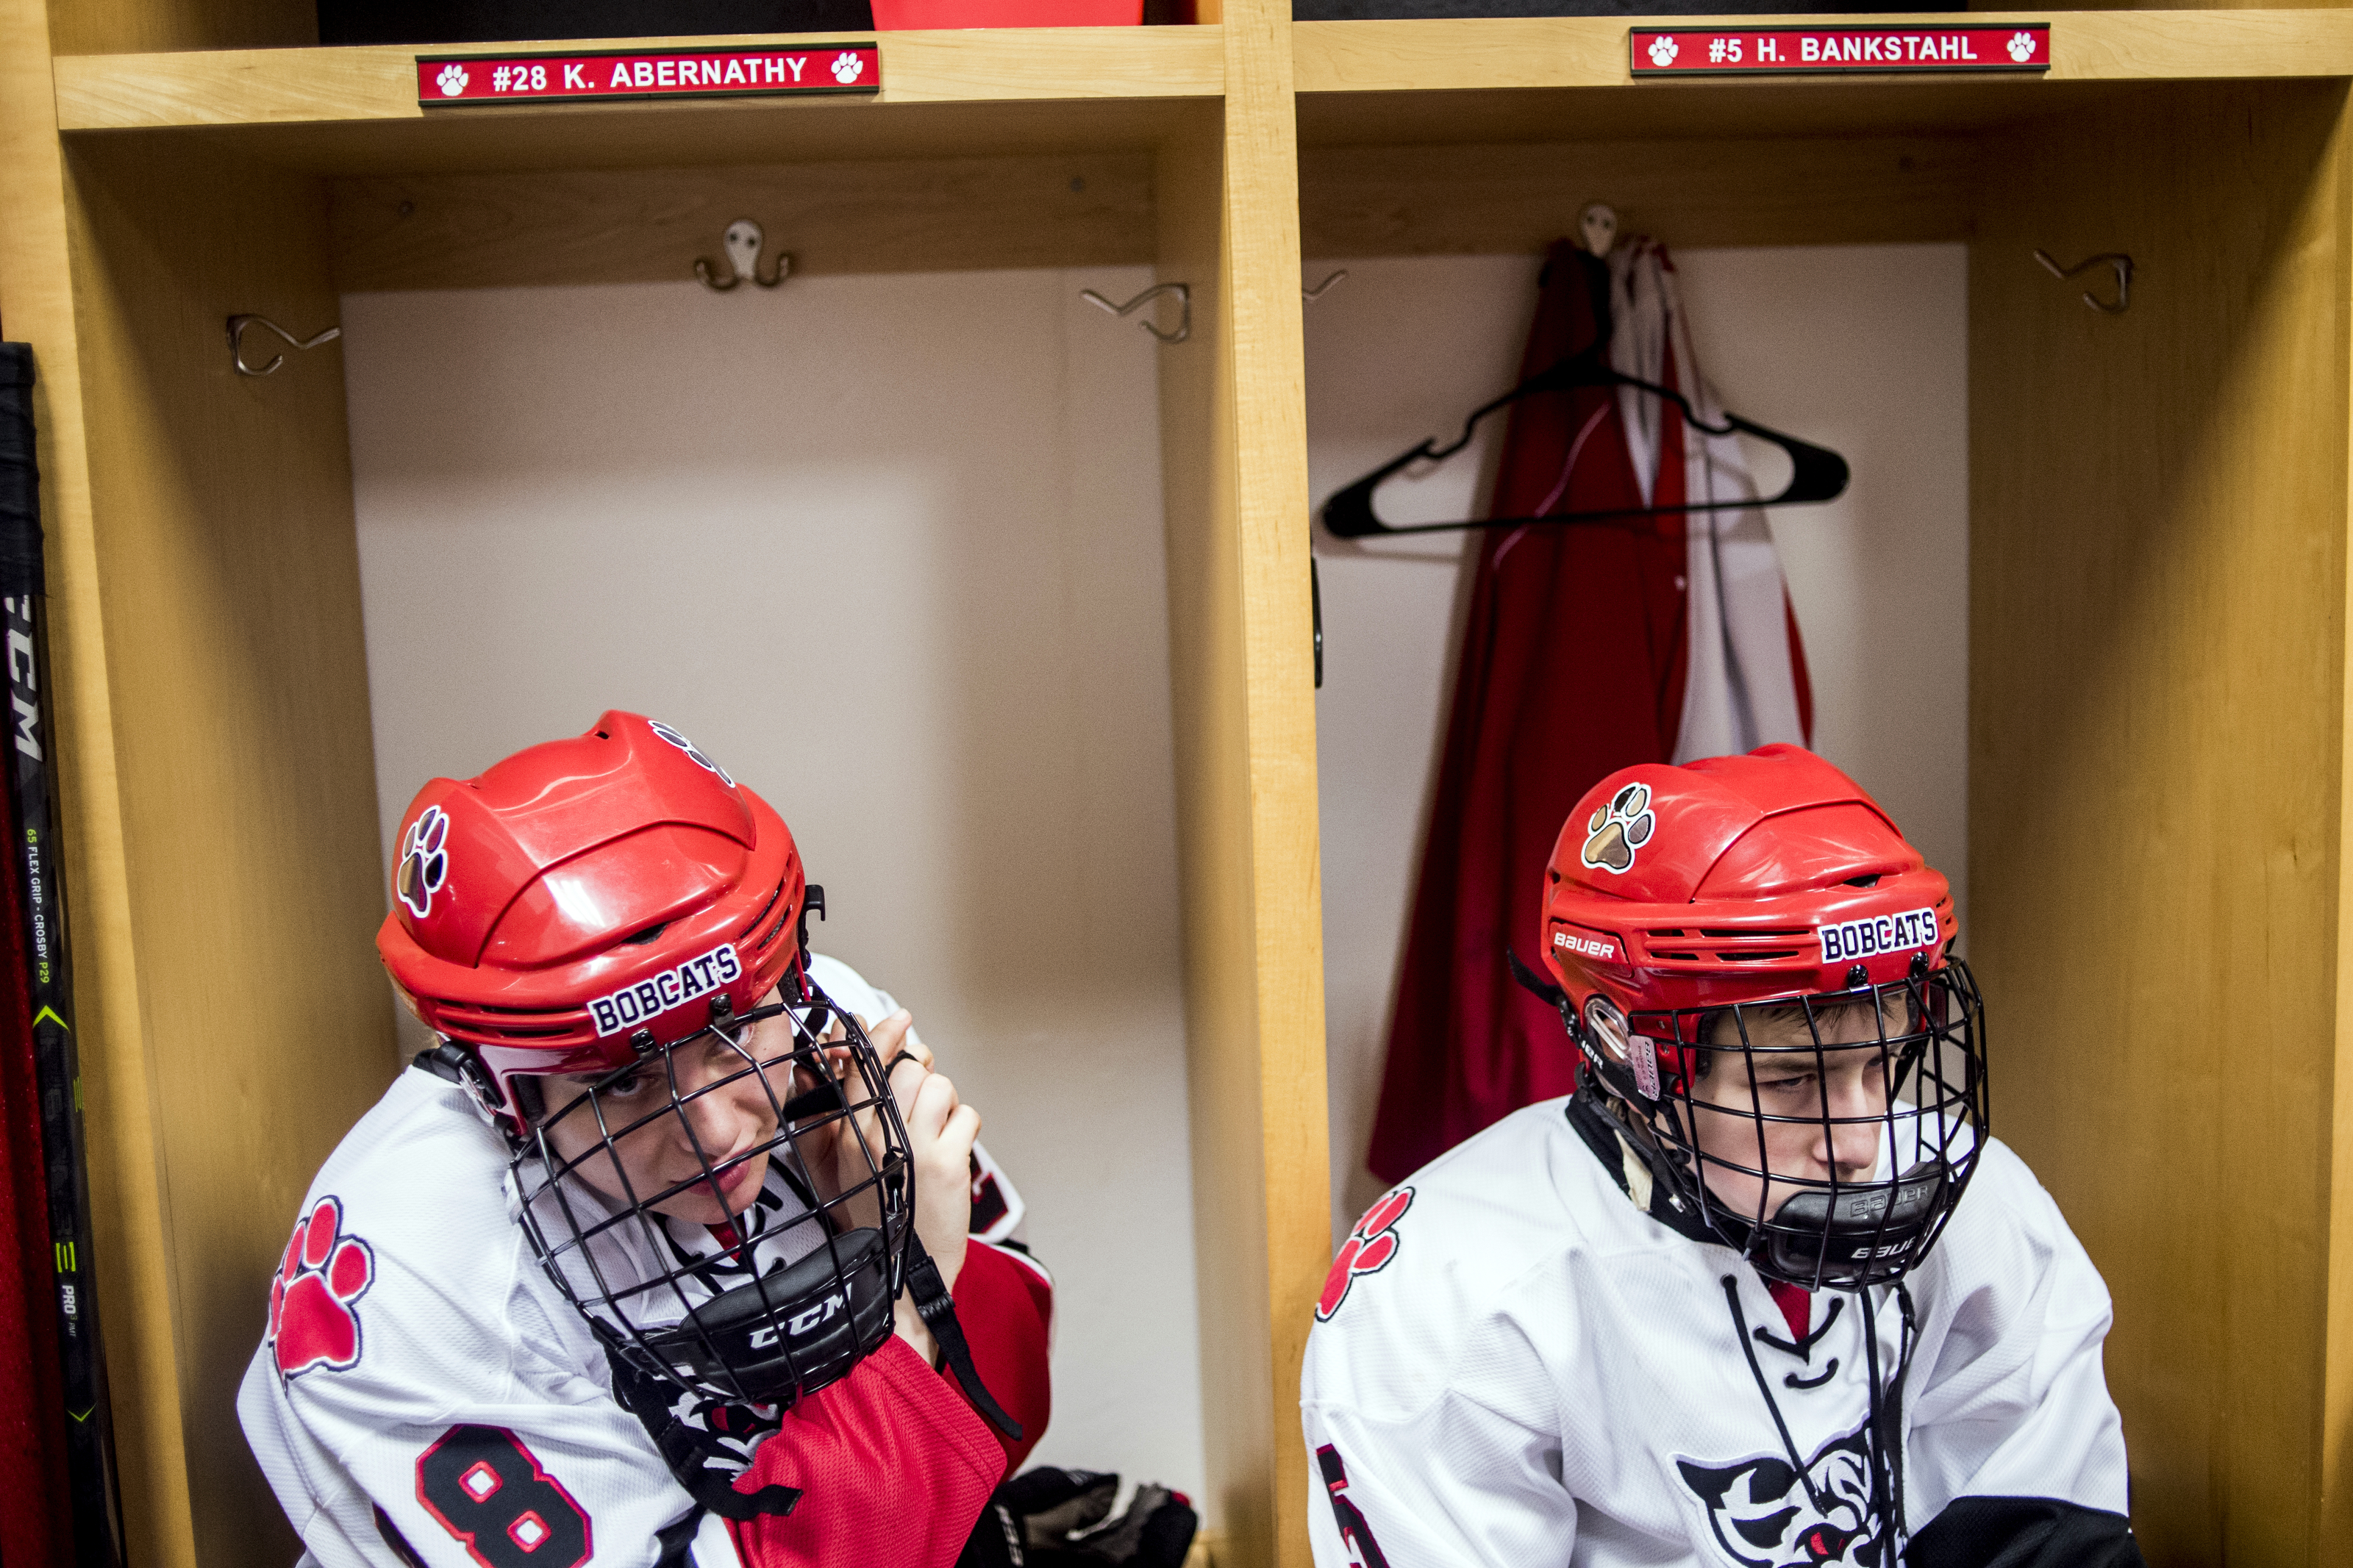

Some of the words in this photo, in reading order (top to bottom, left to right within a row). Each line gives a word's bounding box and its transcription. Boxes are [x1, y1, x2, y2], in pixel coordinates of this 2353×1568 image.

[1708, 38, 1743, 63] #5
[1757, 37, 1786, 62] H.
[1801, 35, 1978, 62] BANKSTAHL
[493, 65, 547, 92] #28
[563, 63, 595, 90] K.
[610, 57, 807, 88] ABERNATHY
[26, 828, 38, 844] 65
[28, 846, 40, 875] FLEX
[32, 877, 43, 905] GRIP
[35, 914, 48, 959] CROSBY
[1554, 932, 1615, 959] BAUER
[1821, 911, 1936, 960] BOBCATS
[39, 962, 50, 984] P29
[592, 946, 738, 1033] BOBCATS
[1851, 1236, 1916, 1259] BAUE
